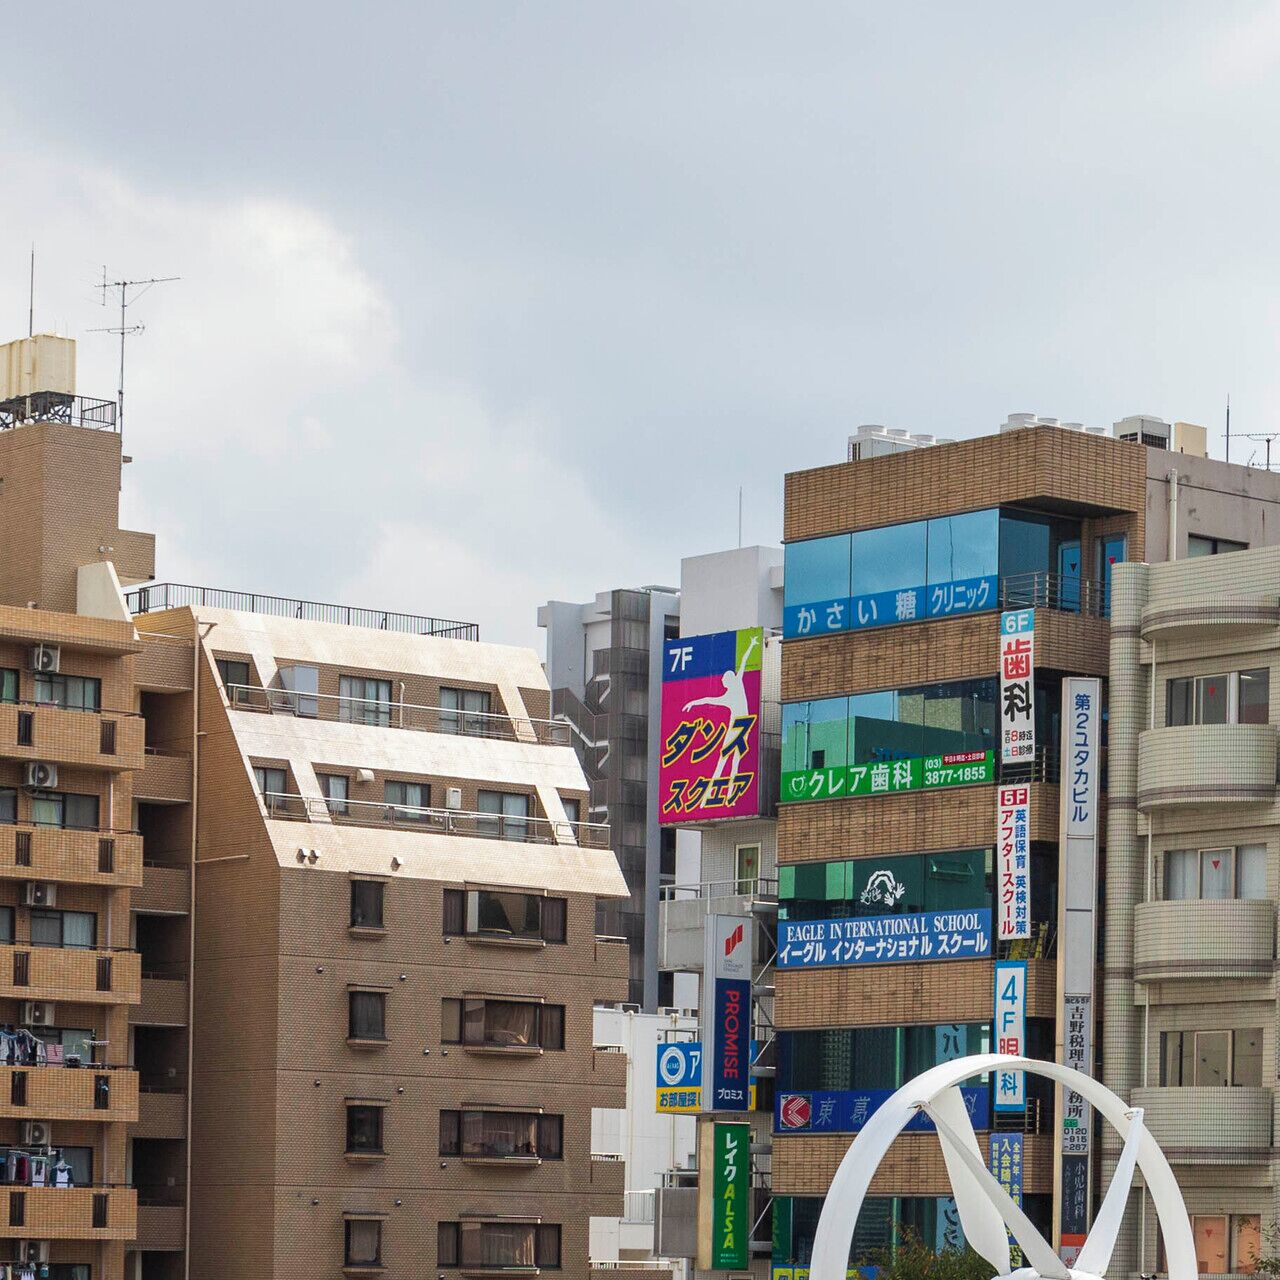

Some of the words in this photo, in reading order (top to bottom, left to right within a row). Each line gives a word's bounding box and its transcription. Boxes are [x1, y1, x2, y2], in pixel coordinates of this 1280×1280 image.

[798, 580, 989, 634] かさい糖クリニック
[1006, 614, 1029, 632] 6F
[669, 646, 692, 673] 7F
[1003, 639, 1033, 722] 歯科
[663, 715, 757, 768] ダンス
[925, 758, 942, 772] (03)
[1072, 693, 1092, 823] 第2ユタカビル
[663, 772, 754, 814] スクエア
[809, 759, 913, 798] クレア歯科
[925, 766, 987, 786] 3877-1855
[1004, 790, 1027, 805] 5F
[1015, 809, 1027, 870] 英語保育
[1001, 810, 1016, 936] アフタースクール
[787, 924, 825, 943] EAGLE
[830, 915, 928, 939] INTERNATIONAL
[934, 912, 981, 932] SCHOOL
[1015, 875, 1027, 936] 英検対策
[780, 943, 826, 963] イーグル
[832, 939, 933, 961] インターナショナル
[937, 931, 988, 953] スクール
[725, 990, 740, 1078] PROMISE
[1068, 1006, 1085, 1119] 吉野税理士務所
[718, 1089, 743, 1100] プロミス
[724, 1133, 738, 1181] レイク
[723, 1183, 736, 1248] ALSA
